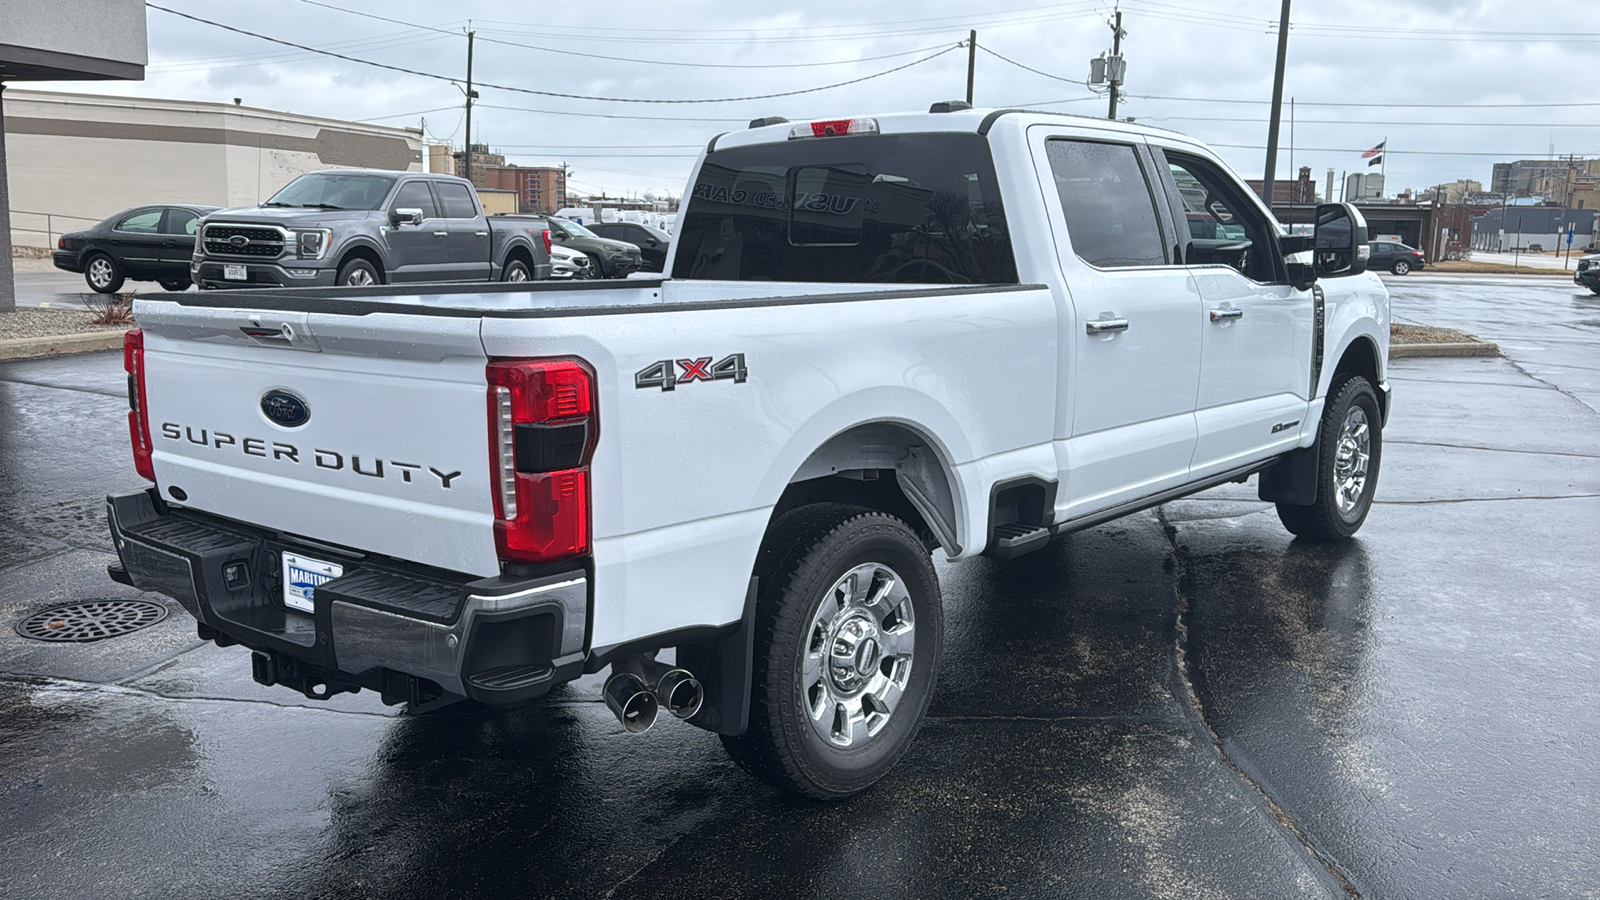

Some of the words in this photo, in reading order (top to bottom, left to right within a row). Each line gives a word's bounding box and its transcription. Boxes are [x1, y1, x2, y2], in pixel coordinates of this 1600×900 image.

[269, 396, 297, 418] Ford
[162, 422, 299, 463] SUPER
[314, 448, 462, 489] DUTY
